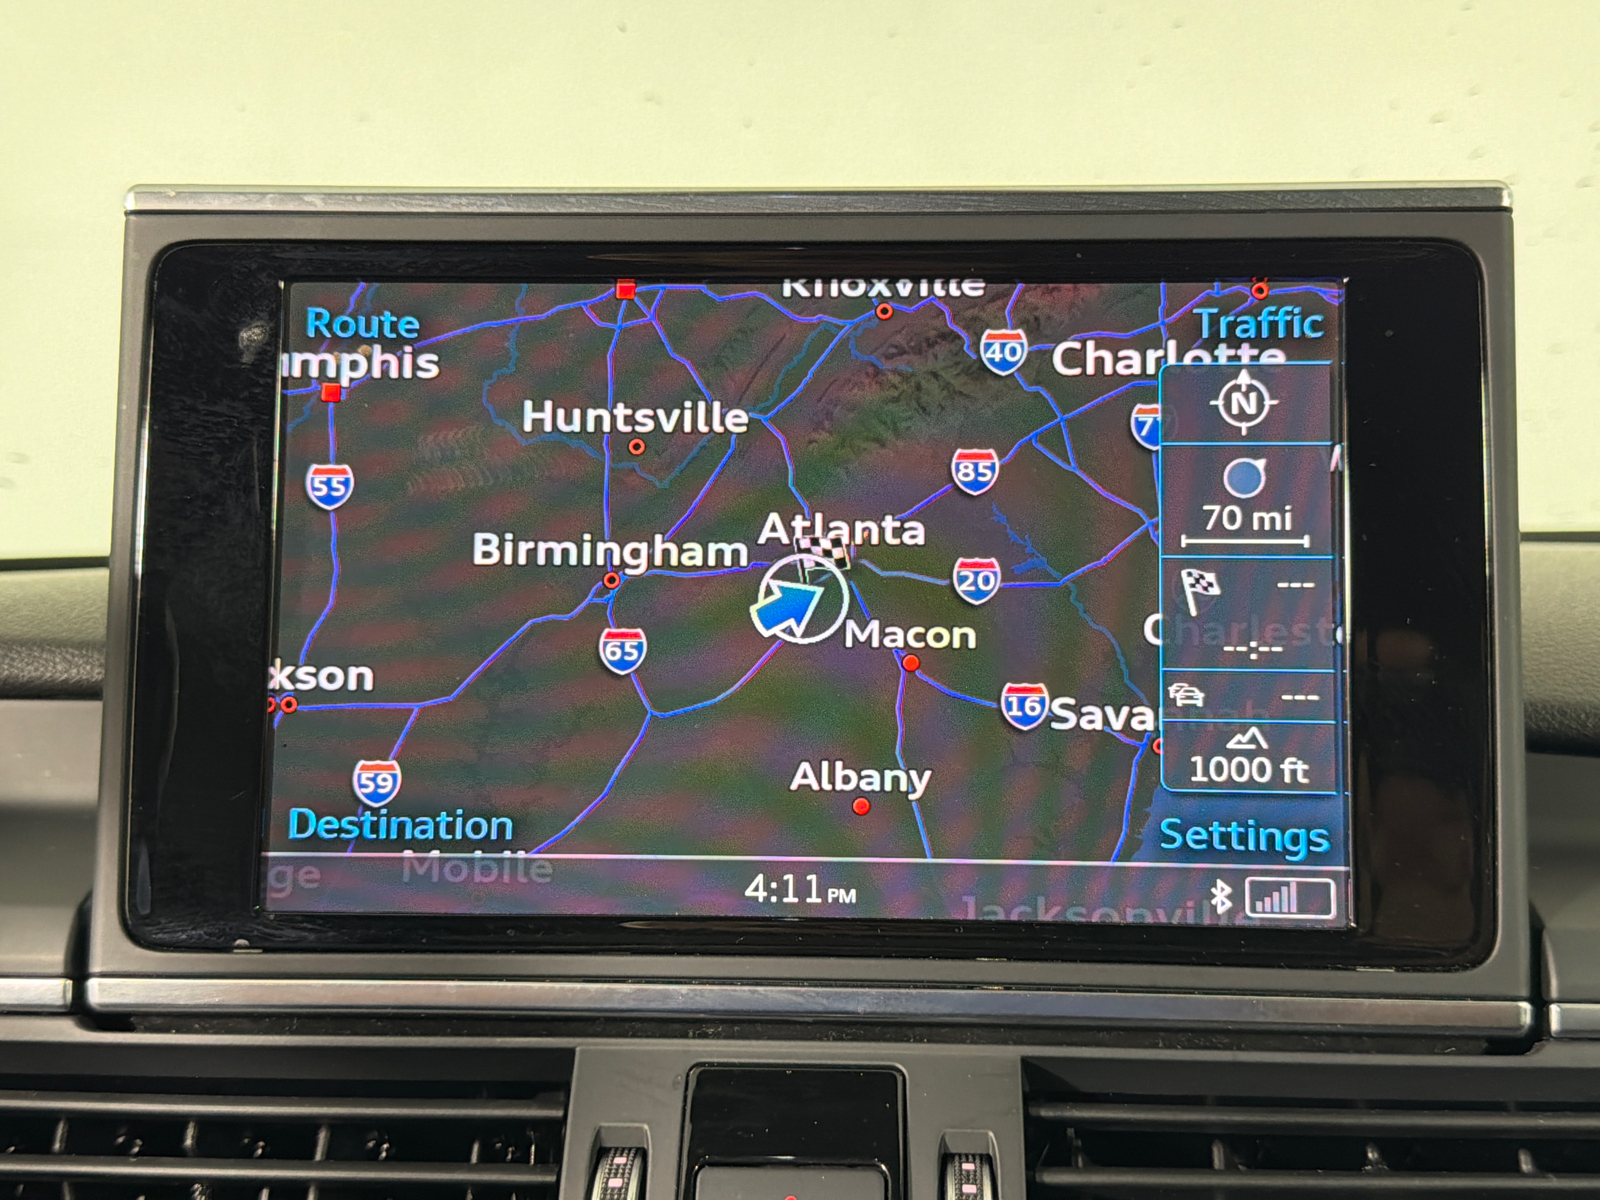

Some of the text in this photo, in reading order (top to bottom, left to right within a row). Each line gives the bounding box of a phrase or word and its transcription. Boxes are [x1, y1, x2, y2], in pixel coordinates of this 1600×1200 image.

[307, 306, 420, 338] Route
[1192, 306, 1324, 339] Traffic
[985, 343, 1020, 363] 40
[1052, 339, 1287, 376] Charlotte
[522, 399, 749, 433] Huntsville
[1231, 392, 1257, 415] N
[312, 477, 345, 497] 55
[957, 462, 993, 482] 85
[757, 512, 926, 546] Atlanta
[1202, 505, 1293, 531] 70 mi
[473, 532, 748, 576] Birmingham
[959, 571, 996, 591] 20
[845, 619, 976, 649] Macon
[604, 642, 639, 662] 65
[1007, 696, 1042, 716] 16
[359, 773, 393, 793] 59
[789, 761, 932, 800] Albany
[1190, 756, 1310, 783] 1000 ft
[288, 808, 513, 840] Destination
[1160, 817, 1331, 862] Settings
[402, 849, 553, 884] Mobile
